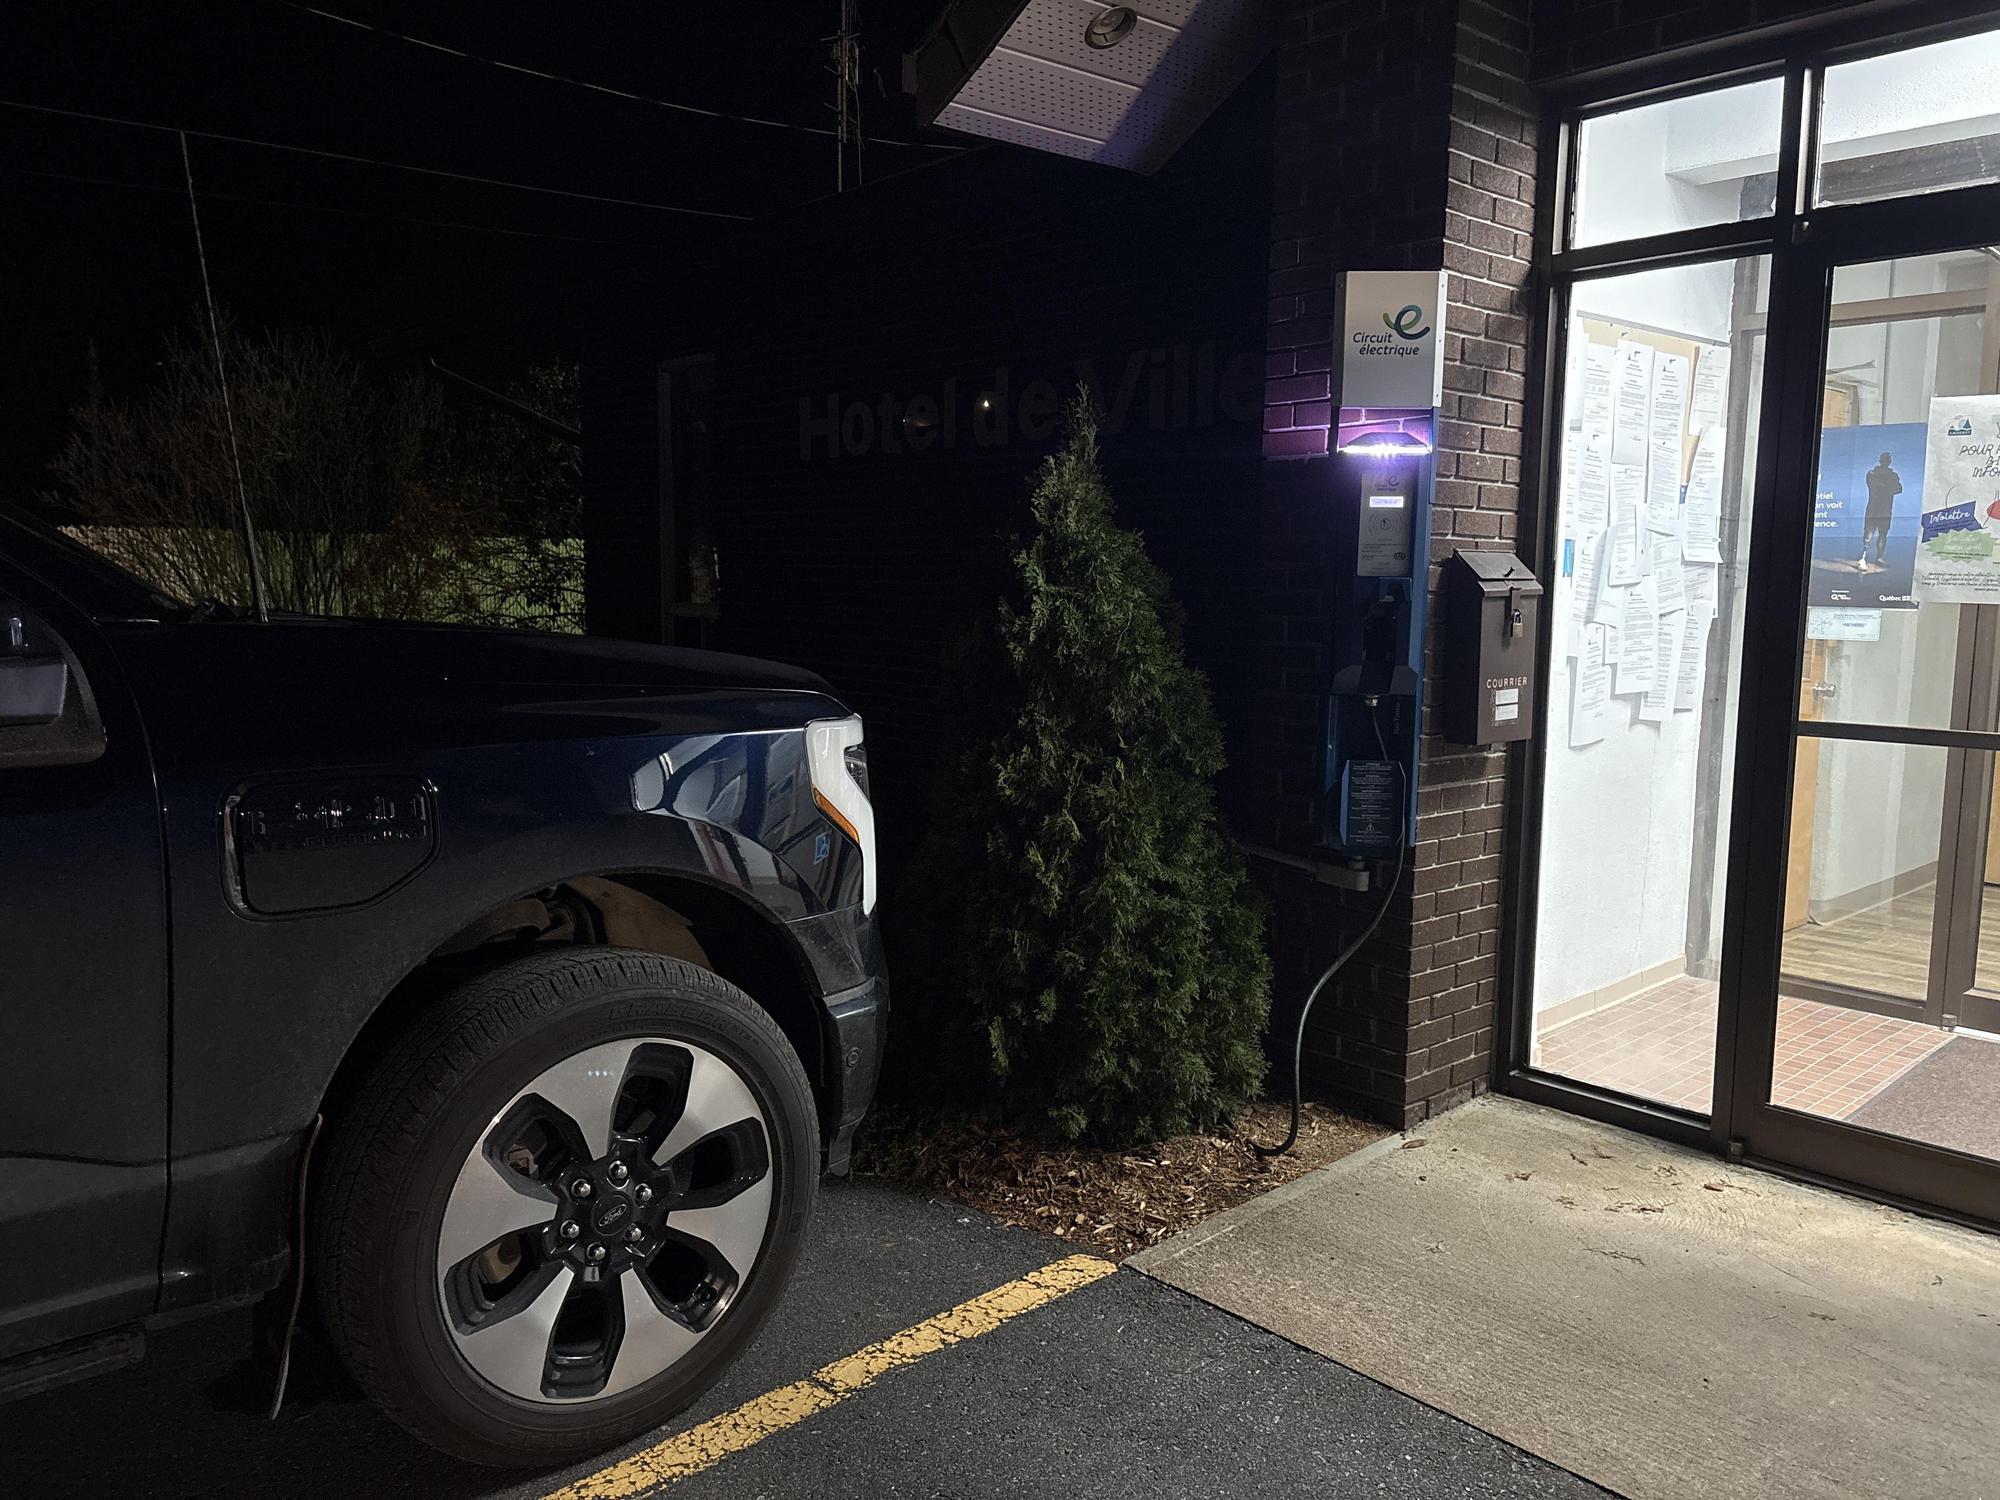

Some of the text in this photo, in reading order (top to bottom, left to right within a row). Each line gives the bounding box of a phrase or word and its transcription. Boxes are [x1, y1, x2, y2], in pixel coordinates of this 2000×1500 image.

[1352, 331, 1394, 343] Circuit
[1359, 343, 1420, 358] électrique
[798, 376, 957, 461] Hotel
[973, 367, 1058, 448] de
[1959, 443, 1994, 456] POUR
[1826, 501, 1843, 509] voit
[1929, 509, 1971, 524] Infolettre
[1486, 676, 1528, 689] COURRIER
